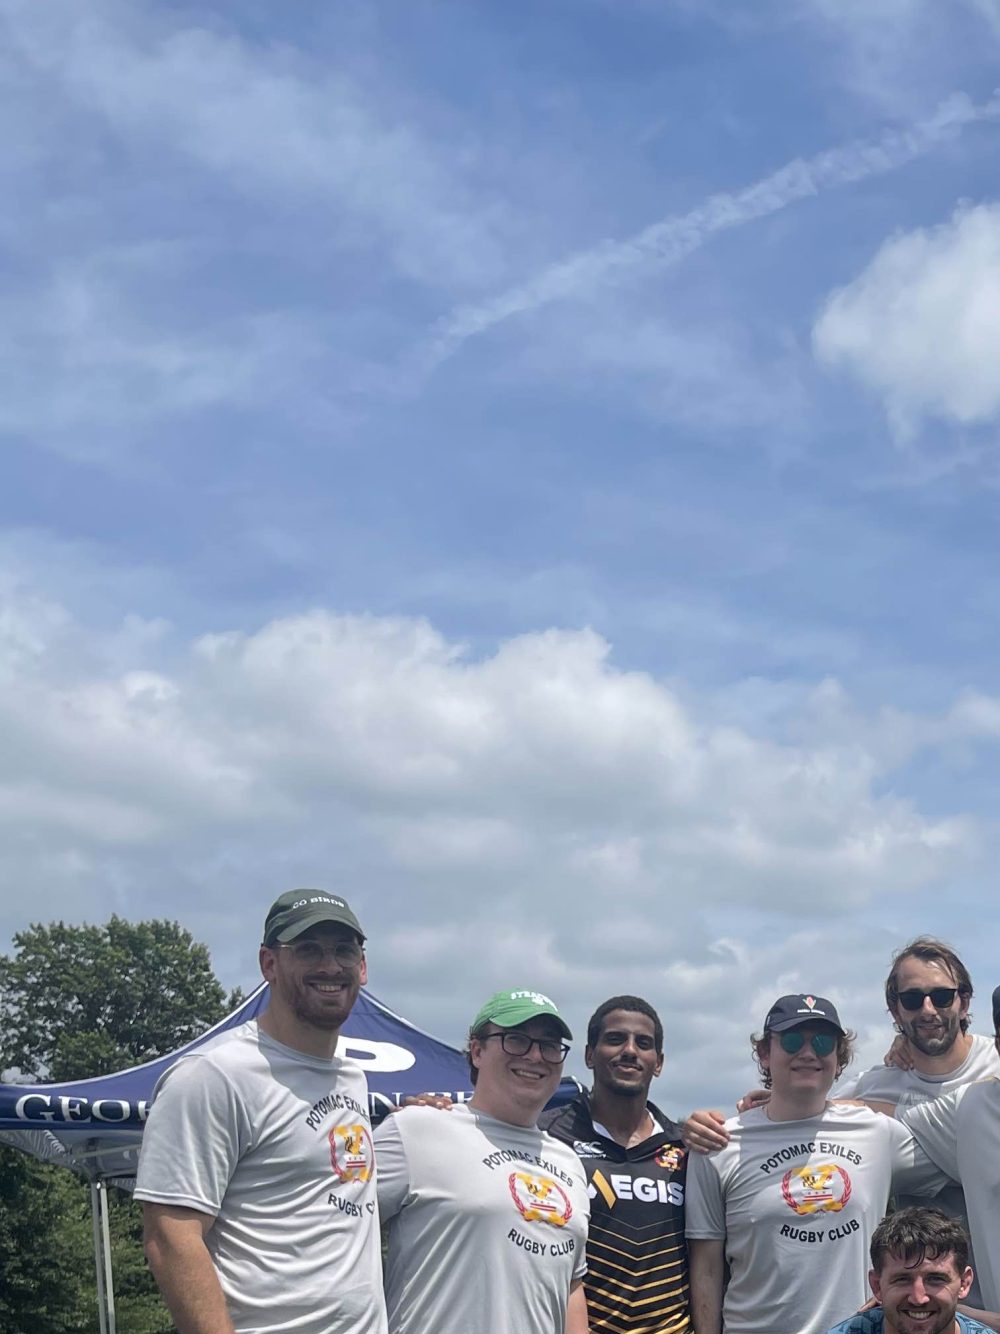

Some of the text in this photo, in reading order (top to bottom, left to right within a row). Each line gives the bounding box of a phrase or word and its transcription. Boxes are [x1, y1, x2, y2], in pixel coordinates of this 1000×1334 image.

[305, 1094, 345, 1132] POTOMAC
[482, 1149, 573, 1187] POTOMAC EXILES
[760, 1142, 862, 1174] POTOMAC EXILES
[327, 1193, 364, 1218] RUGBY
[507, 1228, 575, 1256] RUGBY CLUB
[780, 1219, 860, 1242] RUGBY CLUB
